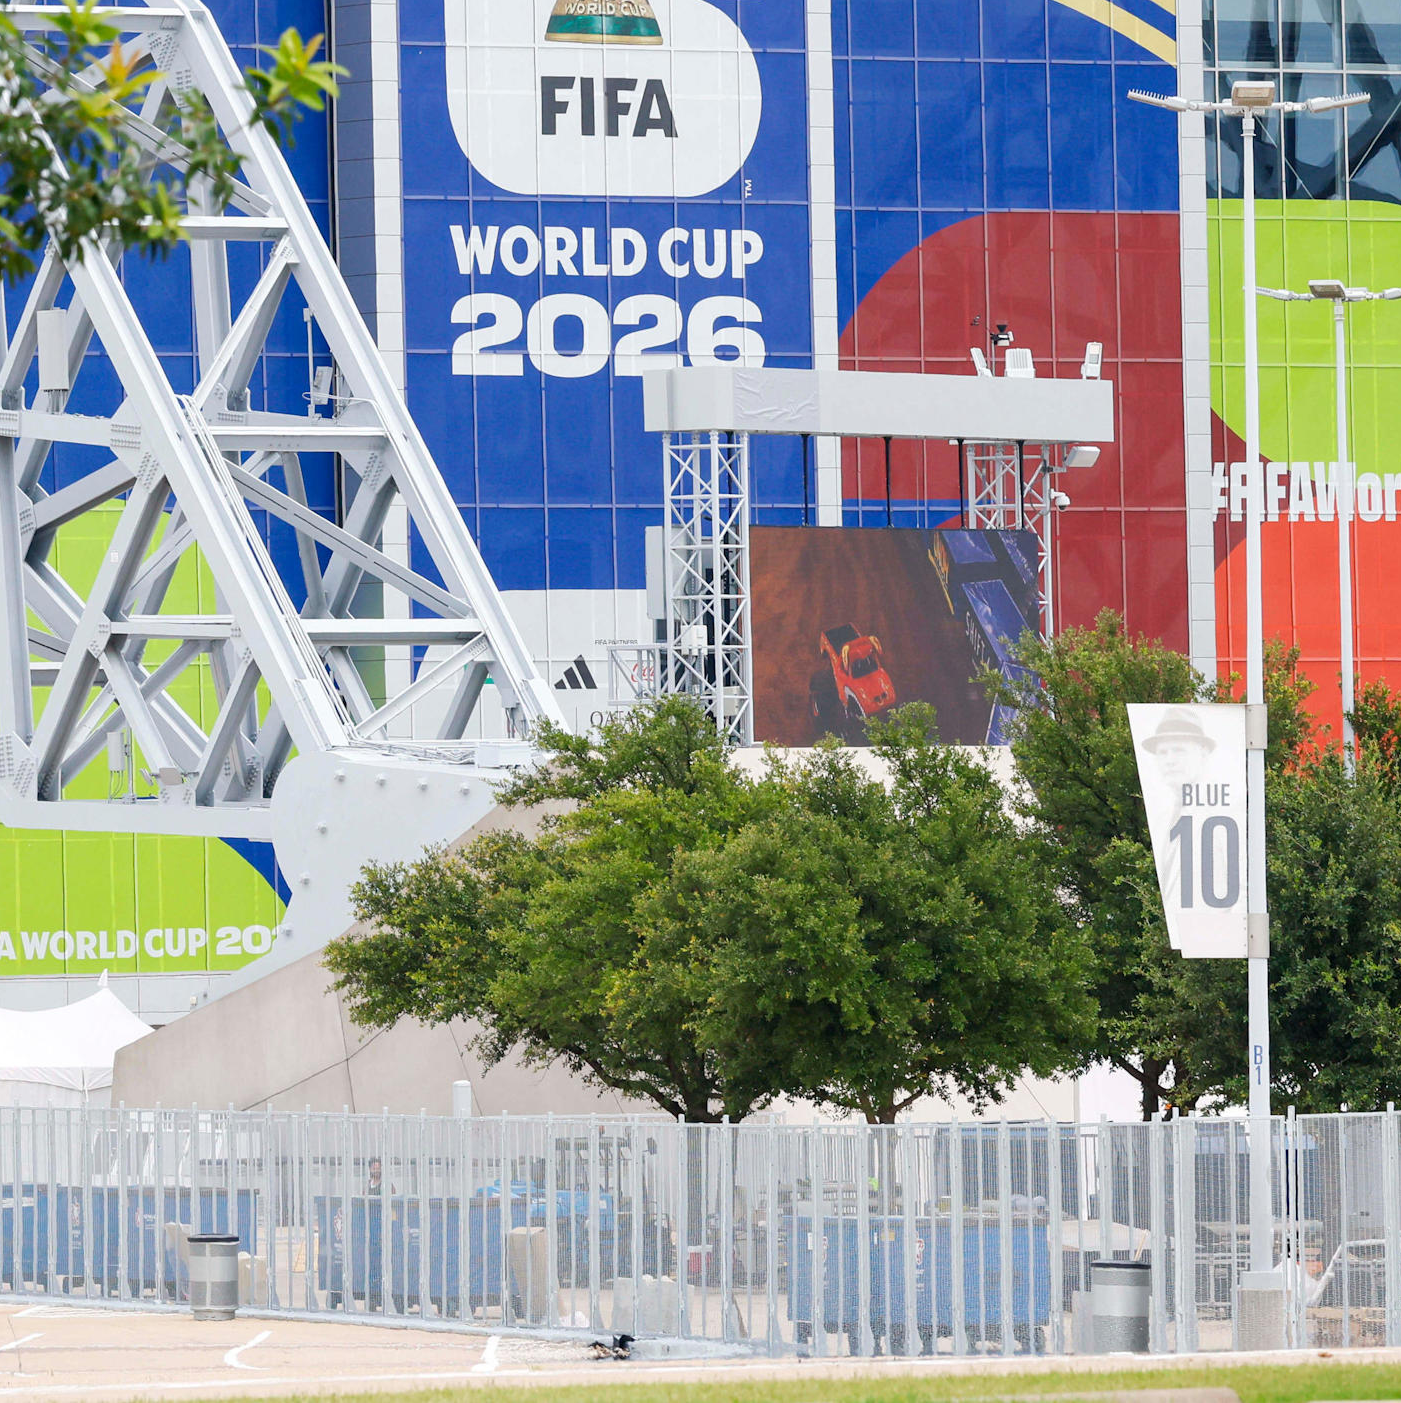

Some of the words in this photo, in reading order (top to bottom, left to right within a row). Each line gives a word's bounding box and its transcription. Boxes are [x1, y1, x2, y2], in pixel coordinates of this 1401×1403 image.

[564, 2, 616, 16] WORLD
[620, 4, 648, 17] CUP
[540, 76, 679, 138] FIFA
[449, 225, 648, 277] WORLD
[658, 227, 765, 279] CUP
[450, 292, 766, 379] 2026
[1181, 783, 1231, 807] BLUE
[1169, 815, 1240, 909] 10
[20, 929, 139, 960] WORLD
[144, 929, 208, 958] CUP
[216, 925, 281, 956] 20
